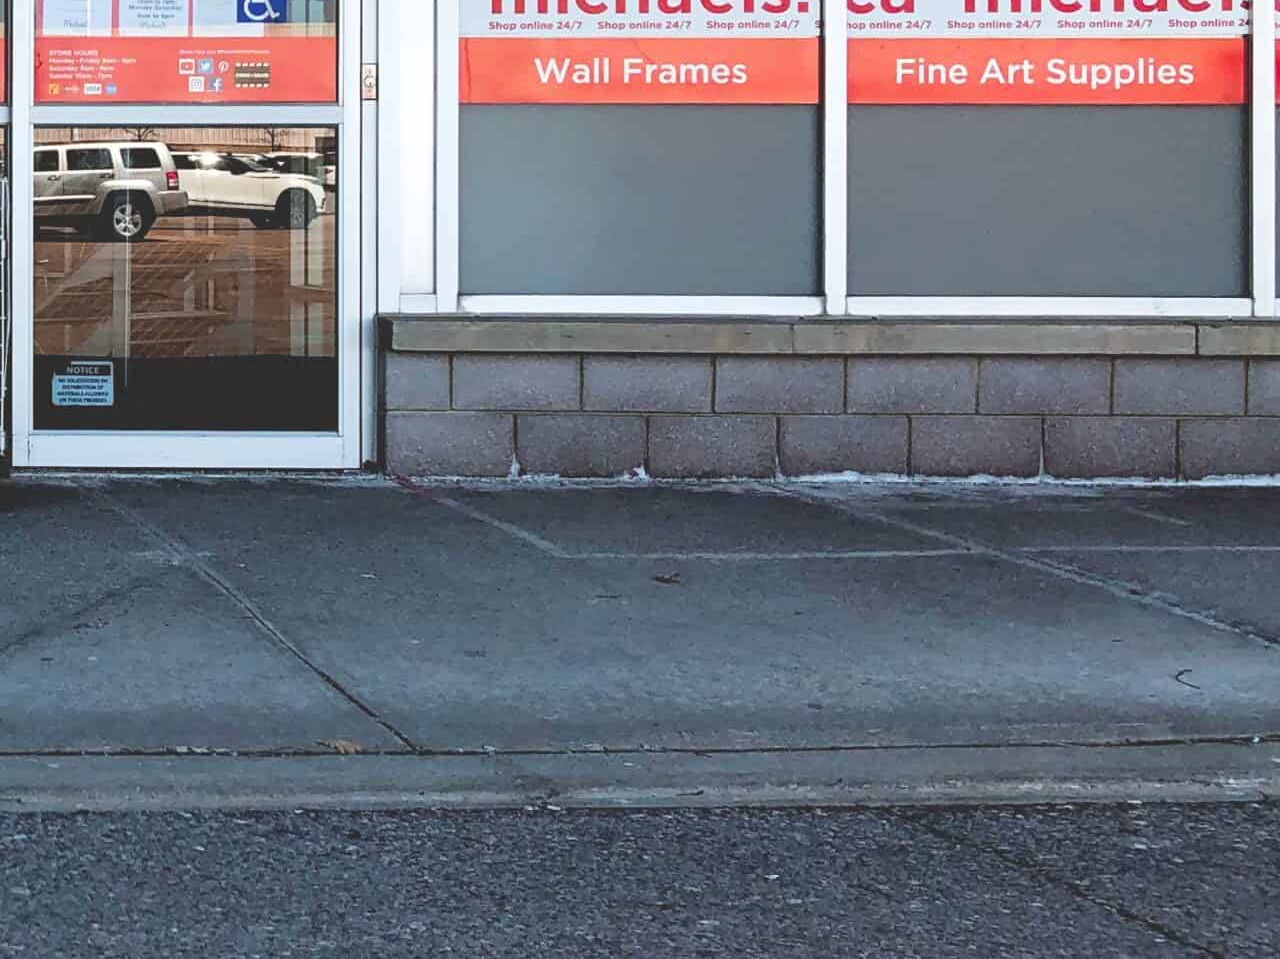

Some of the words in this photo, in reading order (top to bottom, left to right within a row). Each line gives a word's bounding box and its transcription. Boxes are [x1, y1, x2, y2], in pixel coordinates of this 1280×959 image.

[488, 21, 517, 32] Shop
[519, 21, 554, 31] online
[556, 21, 583, 30] 24/7
[597, 21, 626, 31] Shop
[628, 21, 663, 30] online
[665, 20, 692, 30] 24/7
[706, 20, 735, 31] Shop
[737, 20, 771, 30] online
[773, 20, 800, 30] 24/7
[869, 20, 903, 30] online
[905, 20, 933, 30] 24/7
[946, 20, 975, 30] Shop
[978, 20, 1013, 30] online
[1015, 19, 1042, 29] 24/7
[1056, 19, 1086, 30] Shop
[1088, 19, 1123, 29] online
[1126, 19, 1153, 29] 24/7
[1167, 19, 1198, 30] Shop
[1200, 19, 1235, 28] online
[533, 57, 610, 84] Wall
[623, 57, 748, 84] Frames
[895, 57, 968, 84] Fine
[979, 57, 1035, 84] Art
[1046, 57, 1195, 91] Supplies
[66, 366, 99, 374] NOTICE
